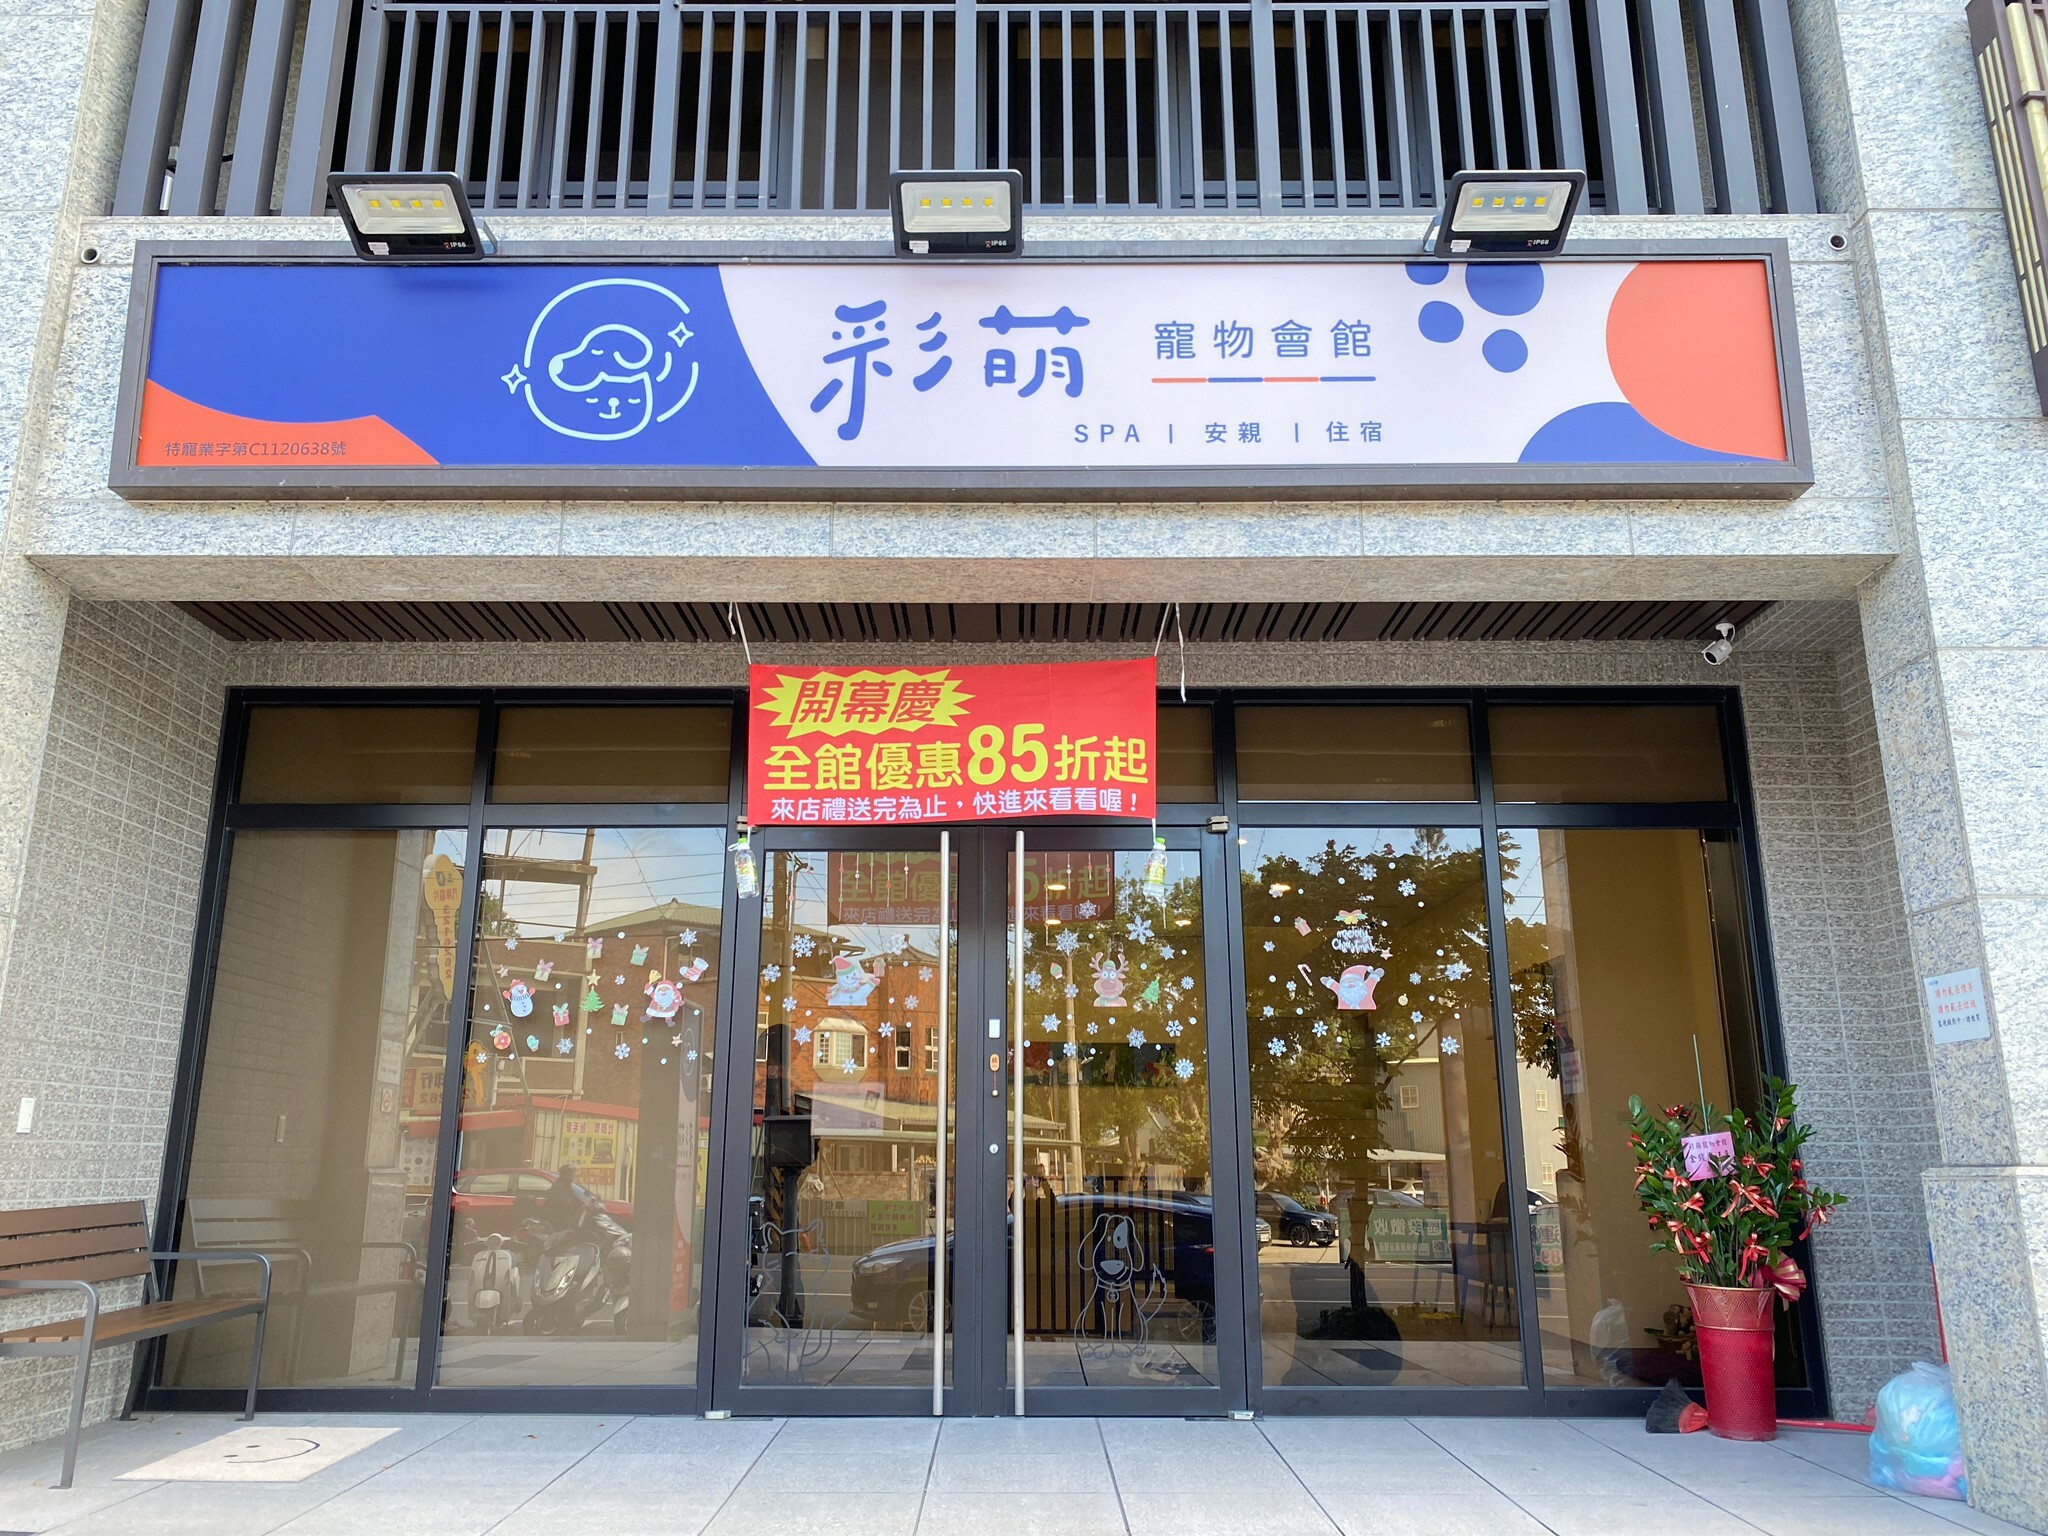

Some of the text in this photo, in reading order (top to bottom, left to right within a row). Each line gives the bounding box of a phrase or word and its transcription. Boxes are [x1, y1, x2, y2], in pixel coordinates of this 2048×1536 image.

[1154, 319, 1372, 360] 寵物會館
[810, 300, 1090, 441] 彩萌
[165, 441, 346, 458] 特寵業字第C1120638號
[1074, 420, 1383, 443] SPA 安親 住宿
[789, 679, 945, 724] 開幕慶
[763, 723, 1149, 791] 全館優惠85折起
